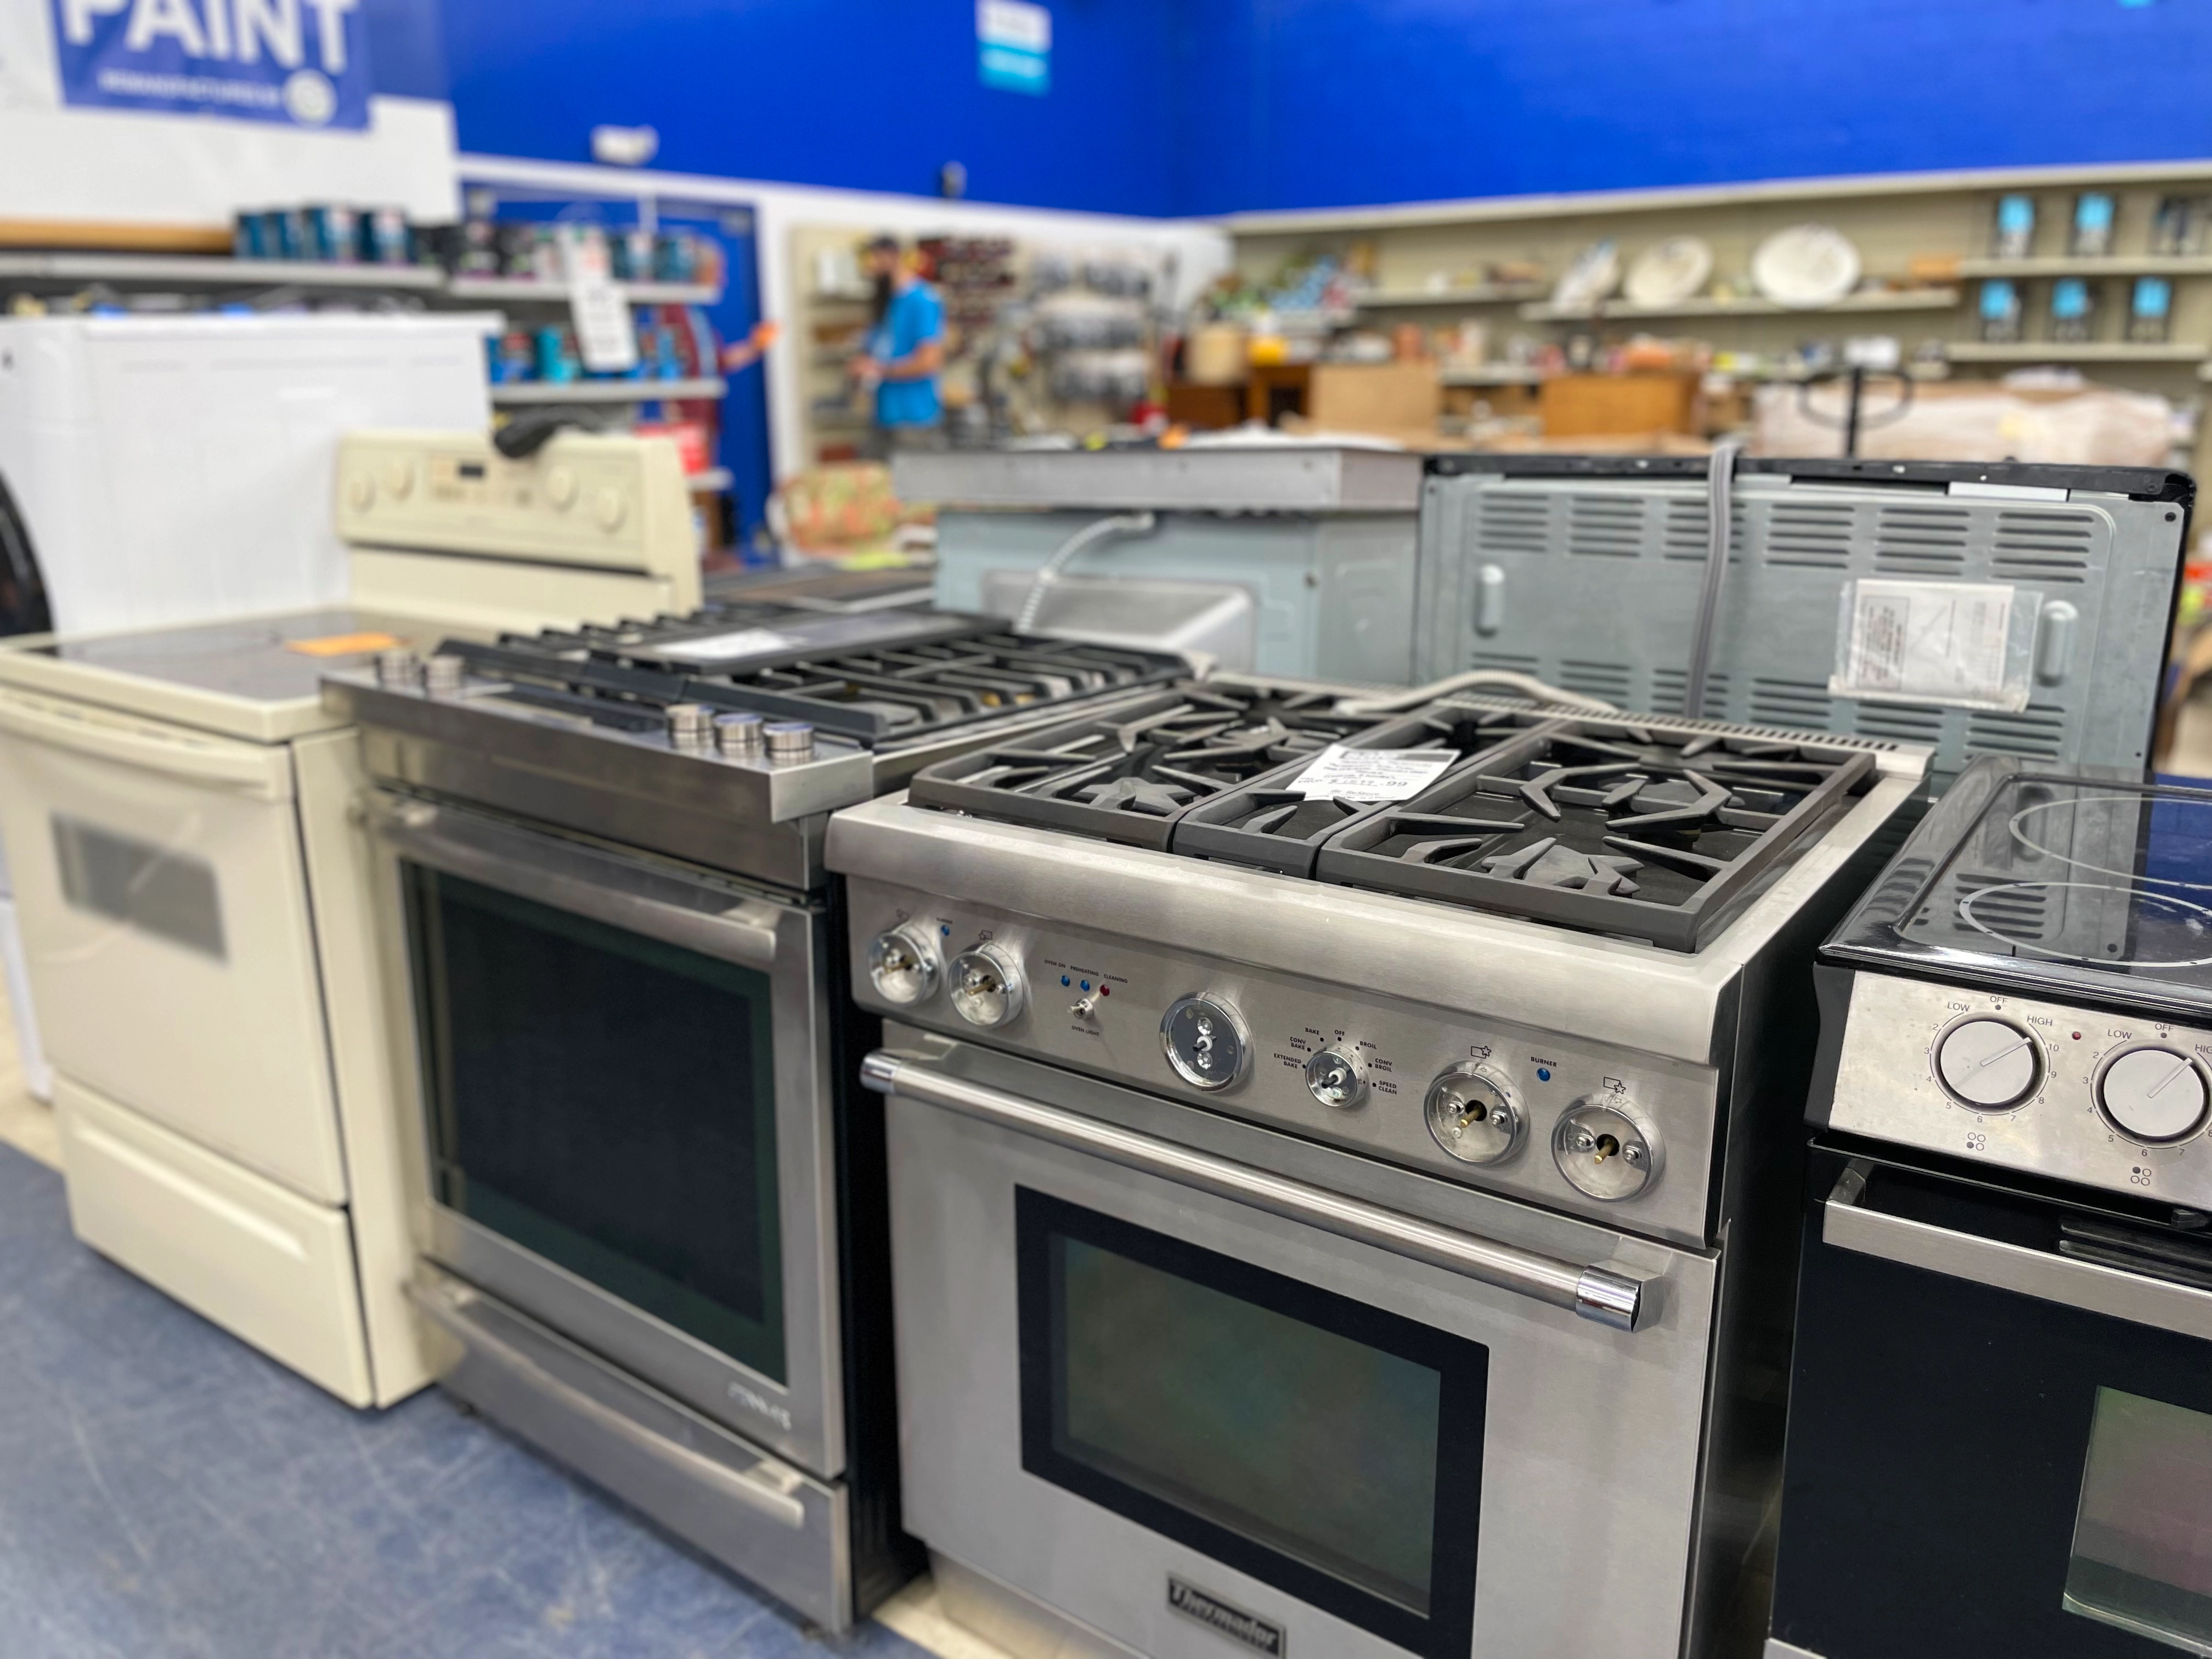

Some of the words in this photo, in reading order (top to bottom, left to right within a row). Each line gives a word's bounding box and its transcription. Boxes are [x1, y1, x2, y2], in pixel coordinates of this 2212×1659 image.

[61, 0, 356, 74] PAINT
[1070, 966, 1099, 977] PREHEATING
[1104, 974, 1128, 984] CLEANING
[1990, 996, 2008, 1005] OFF
[1947, 1002, 1970, 1012] LOW
[2027, 1015, 2053, 1026] HIGH
[2155, 1023, 2174, 1032] OFF
[2108, 1029, 2132, 1040] LOW
[1359, 1041, 1377, 1049] BROIL
[2049, 1043, 2059, 1052] 10
[2195, 1043, 2212, 1054] HIG
[1274, 1053, 1302, 1064] EXTENDED
[1375, 1058, 1392, 1066] CONV
[1531, 1057, 1557, 1067] BURNER
[1375, 1064, 1392, 1072] BROIL
[1379, 1080, 1397, 1088] SPEED
[1379, 1086, 1397, 1094] CLEAN
